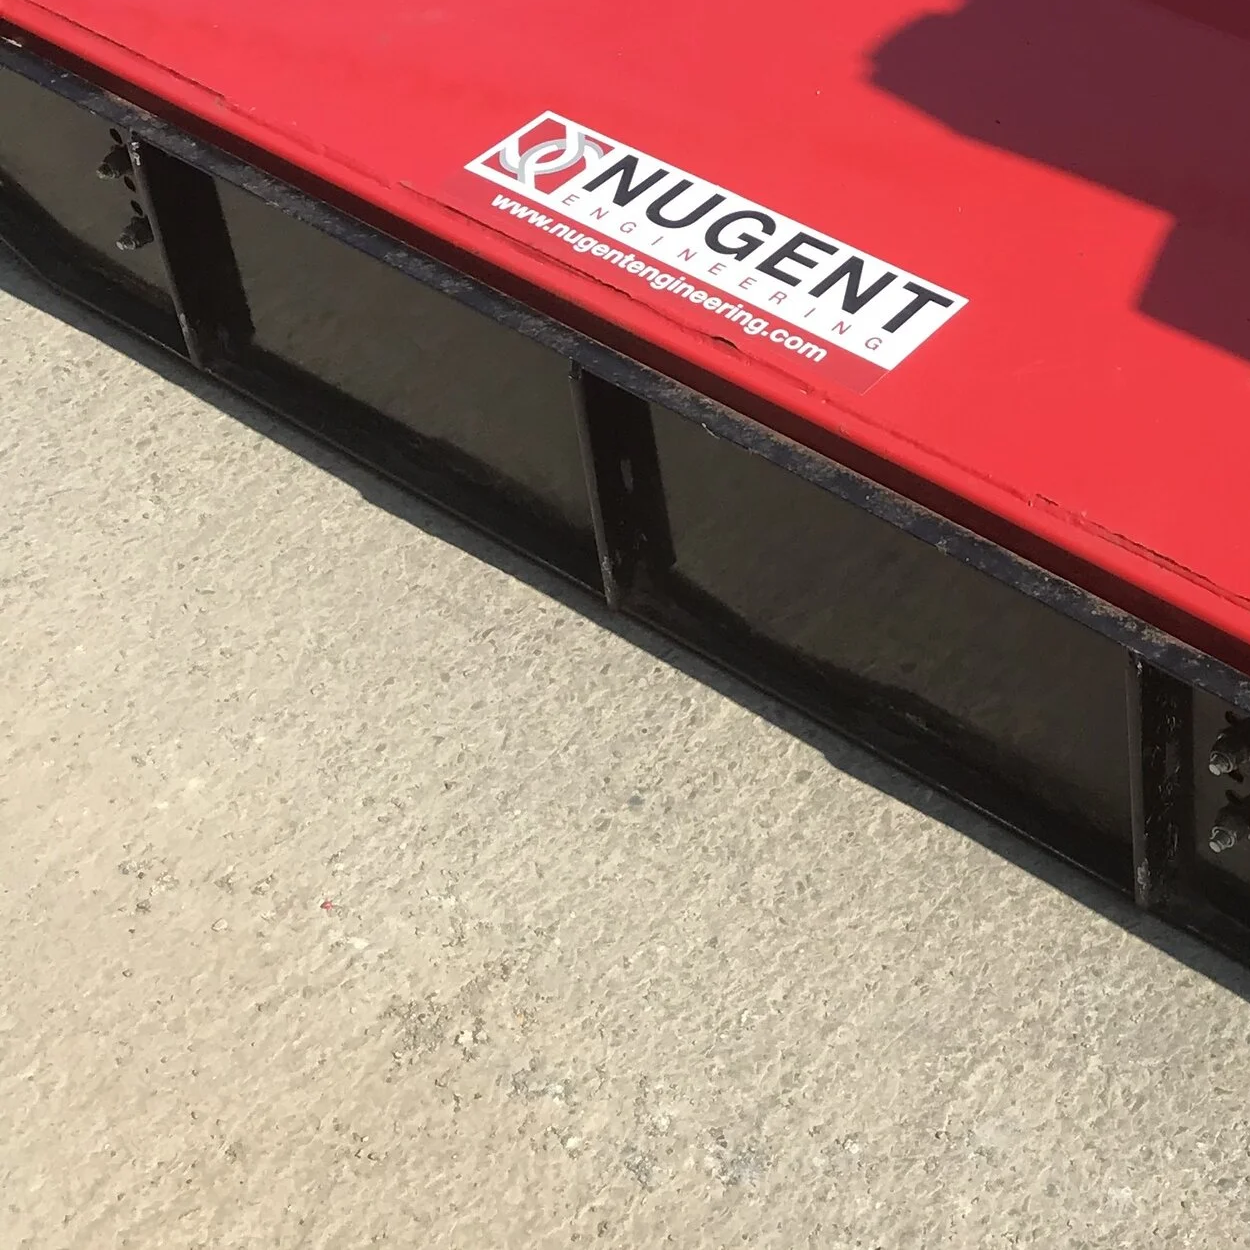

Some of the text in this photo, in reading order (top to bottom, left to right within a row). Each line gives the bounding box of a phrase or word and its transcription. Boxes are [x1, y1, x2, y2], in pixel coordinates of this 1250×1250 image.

[491, 193, 828, 363] www.nugentengineering.com
[561, 194, 881, 351] ENGINEERING
[582, 154, 954, 334] NUGENT
